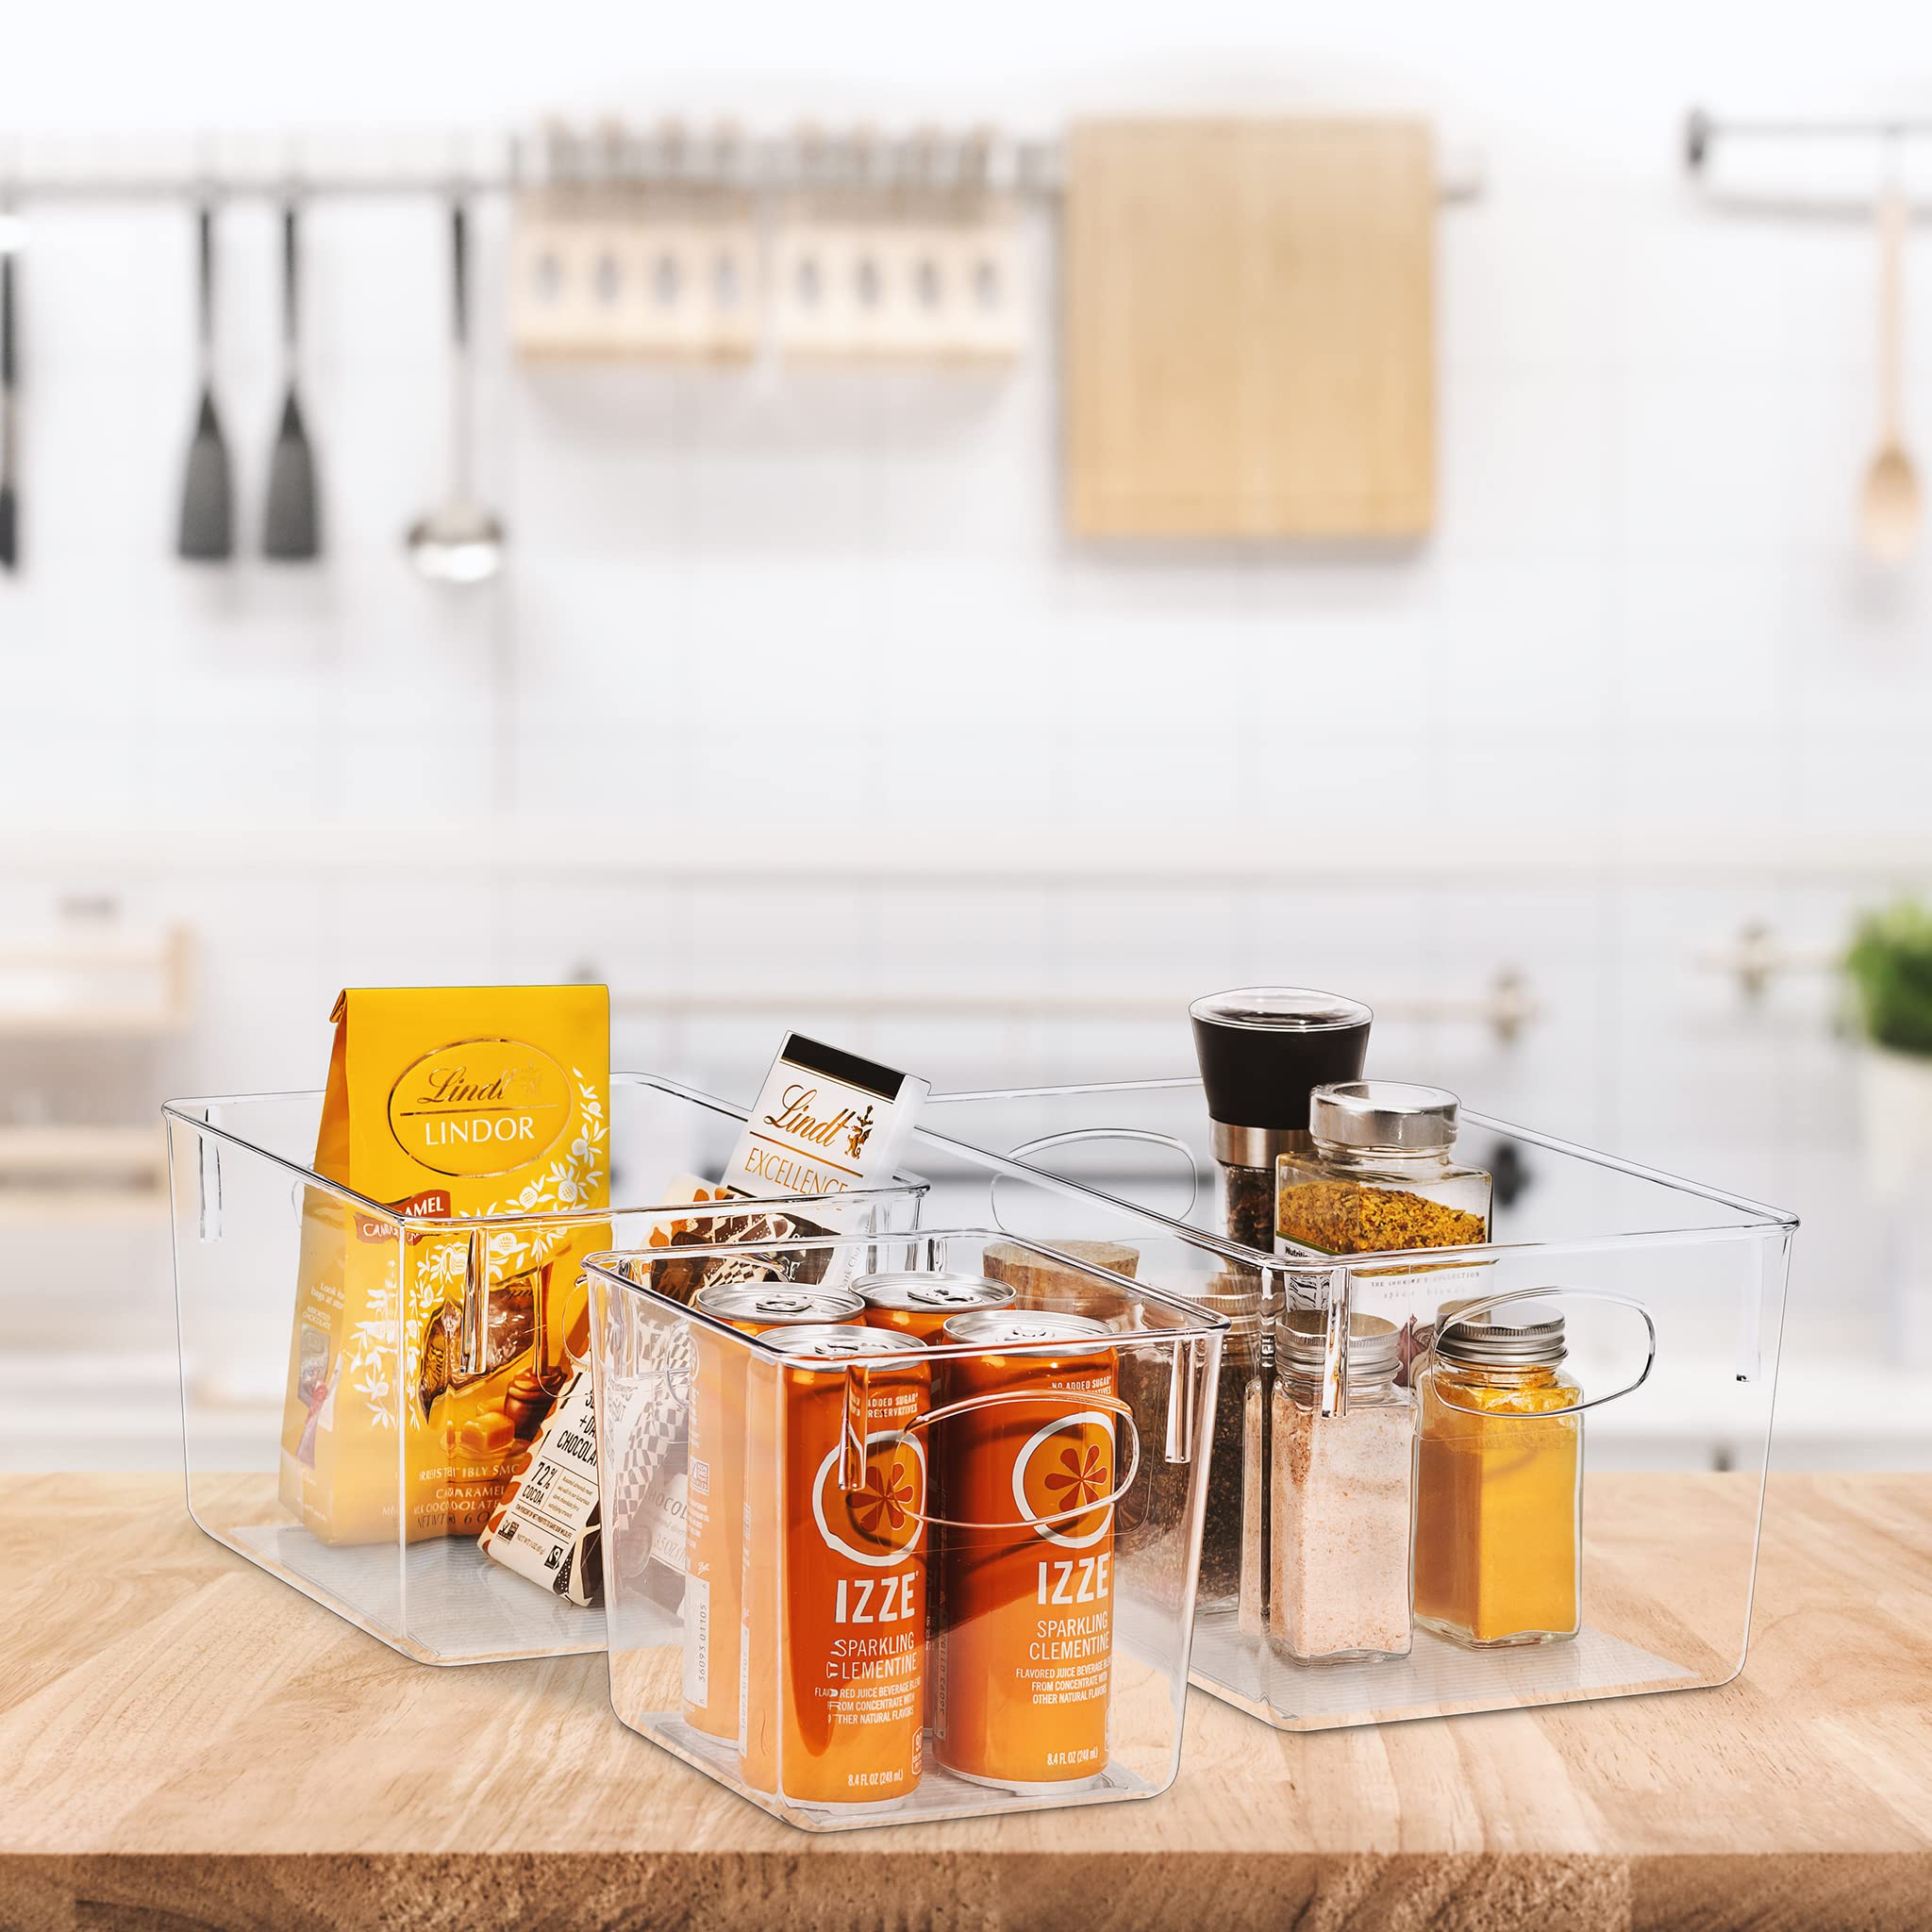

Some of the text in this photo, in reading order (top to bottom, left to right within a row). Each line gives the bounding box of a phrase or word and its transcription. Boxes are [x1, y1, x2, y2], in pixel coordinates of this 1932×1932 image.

[417, 1066, 517, 1104] Lindt
[763, 1084, 857, 1147] Lindt
[425, 1116, 535, 1145] LINDOR
[1066, 1380, 1091, 1391] ADDED
[867, 1404, 918, 1419] RESERVATIVES
[557, 1429, 597, 1467] CHOCOLA
[530, 1461, 558, 1490] 72%
[522, 1484, 544, 1506] COCOA
[1038, 1551, 1110, 1605] IZZE
[835, 1571, 918, 1623] IZZE
[699, 1604, 708, 1641] 01105
[1037, 1610, 1108, 1639] SPARKLING
[830, 1631, 914, 1657] SPARKLING
[1029, 1631, 1110, 1660] CLEMENTINE
[698, 1646, 707, 1683] 36093
[825, 1652, 917, 1680] CLEMENTINE
[1016, 1668, 1056, 1679] FLAVORED
[1056, 1666, 1075, 1678] JUICE
[1076, 1659, 1104, 1676] BEVERAGE
[857, 1688, 876, 1698] JUICE
[878, 1681, 909, 1697] BEVERAGE
[1032, 1680, 1054, 1691] FROM
[1055, 1675, 1099, 1691] CONCENTRATE
[1033, 1683, 1108, 1705] OTHER NATURAL FLAVORS
[856, 1696, 903, 1711] CONCENTRATE
[859, 1710, 891, 1724] NATURAL
[1047, 1753, 1058, 1766] 8.4
[1059, 1752, 1067, 1765] FL
[1068, 1751, 1076, 1764] OZ
[848, 1774, 859, 1787] 8.4
[860, 1774, 869, 1786] FL
[870, 1773, 879, 1786] OZ
